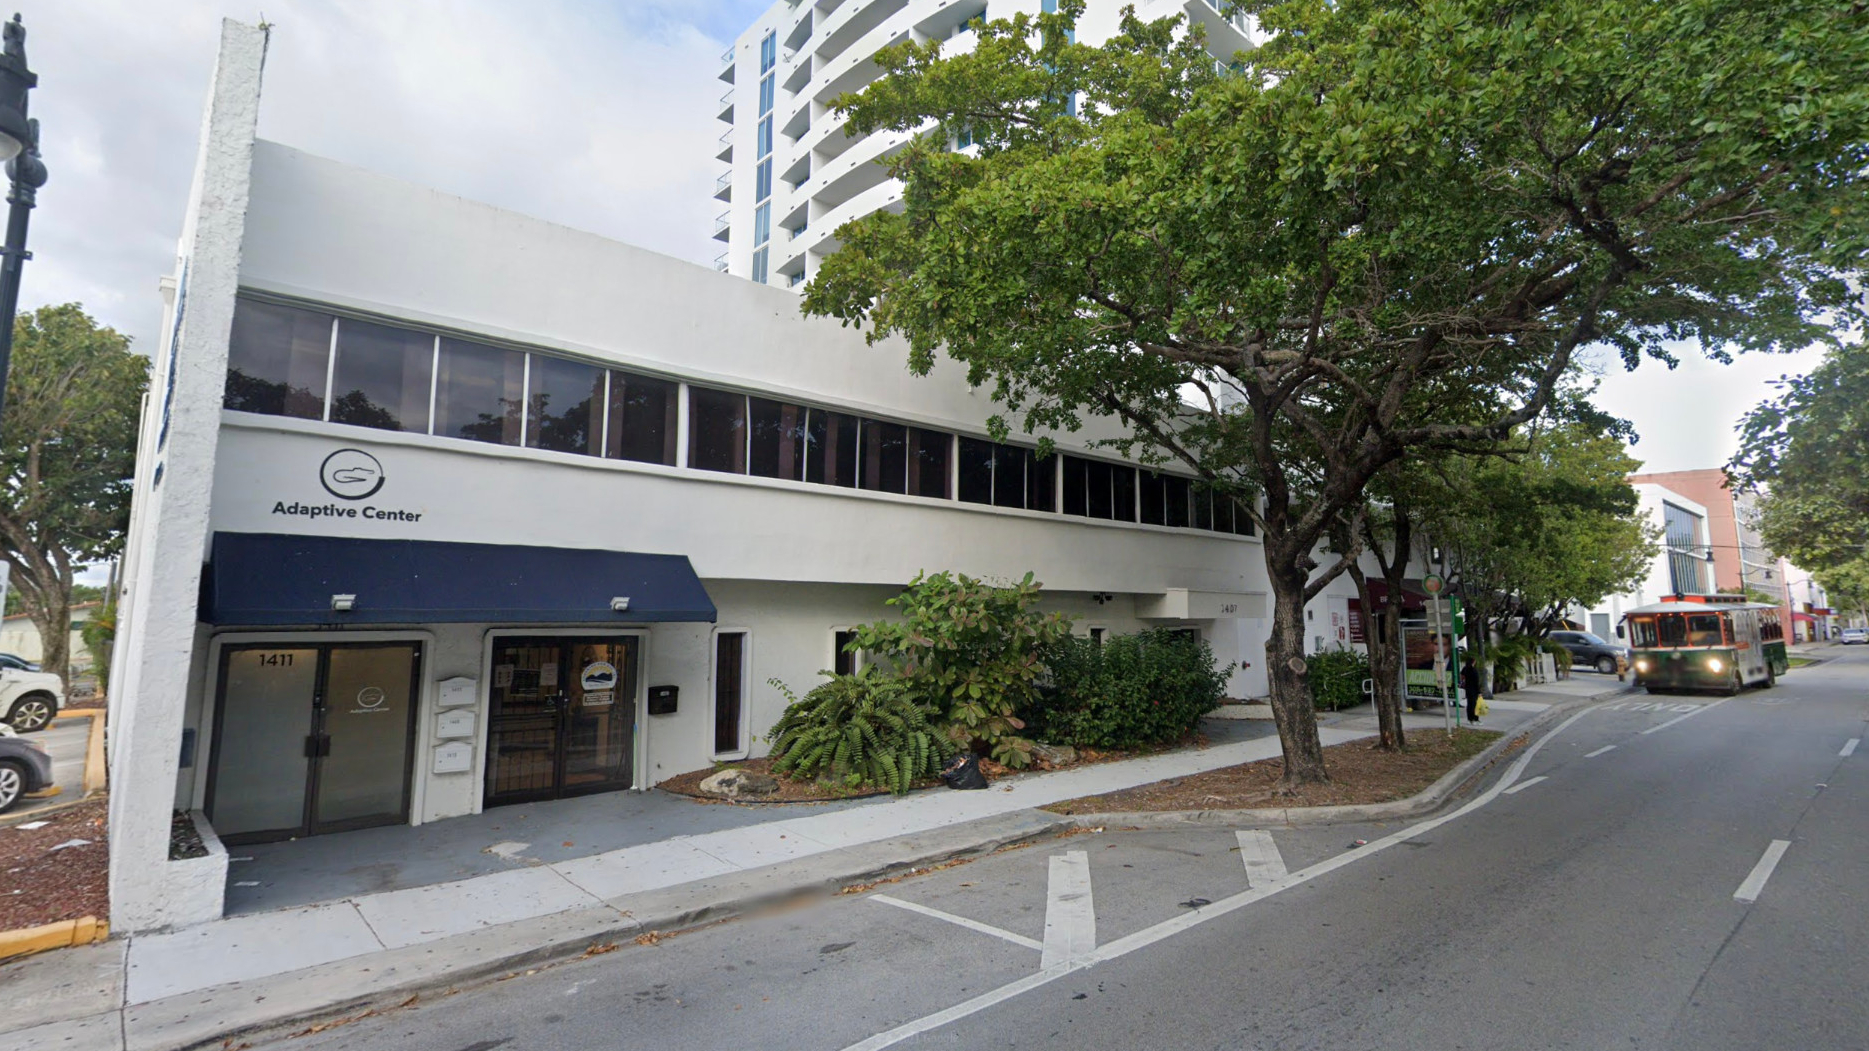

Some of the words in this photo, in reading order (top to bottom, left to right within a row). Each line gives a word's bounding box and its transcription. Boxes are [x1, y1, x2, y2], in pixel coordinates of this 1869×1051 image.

[272, 501, 357, 519] Adaptive
[362, 506, 422, 522] Center
[1221, 604, 1238, 613] 1407
[259, 654, 294, 666] 1411
